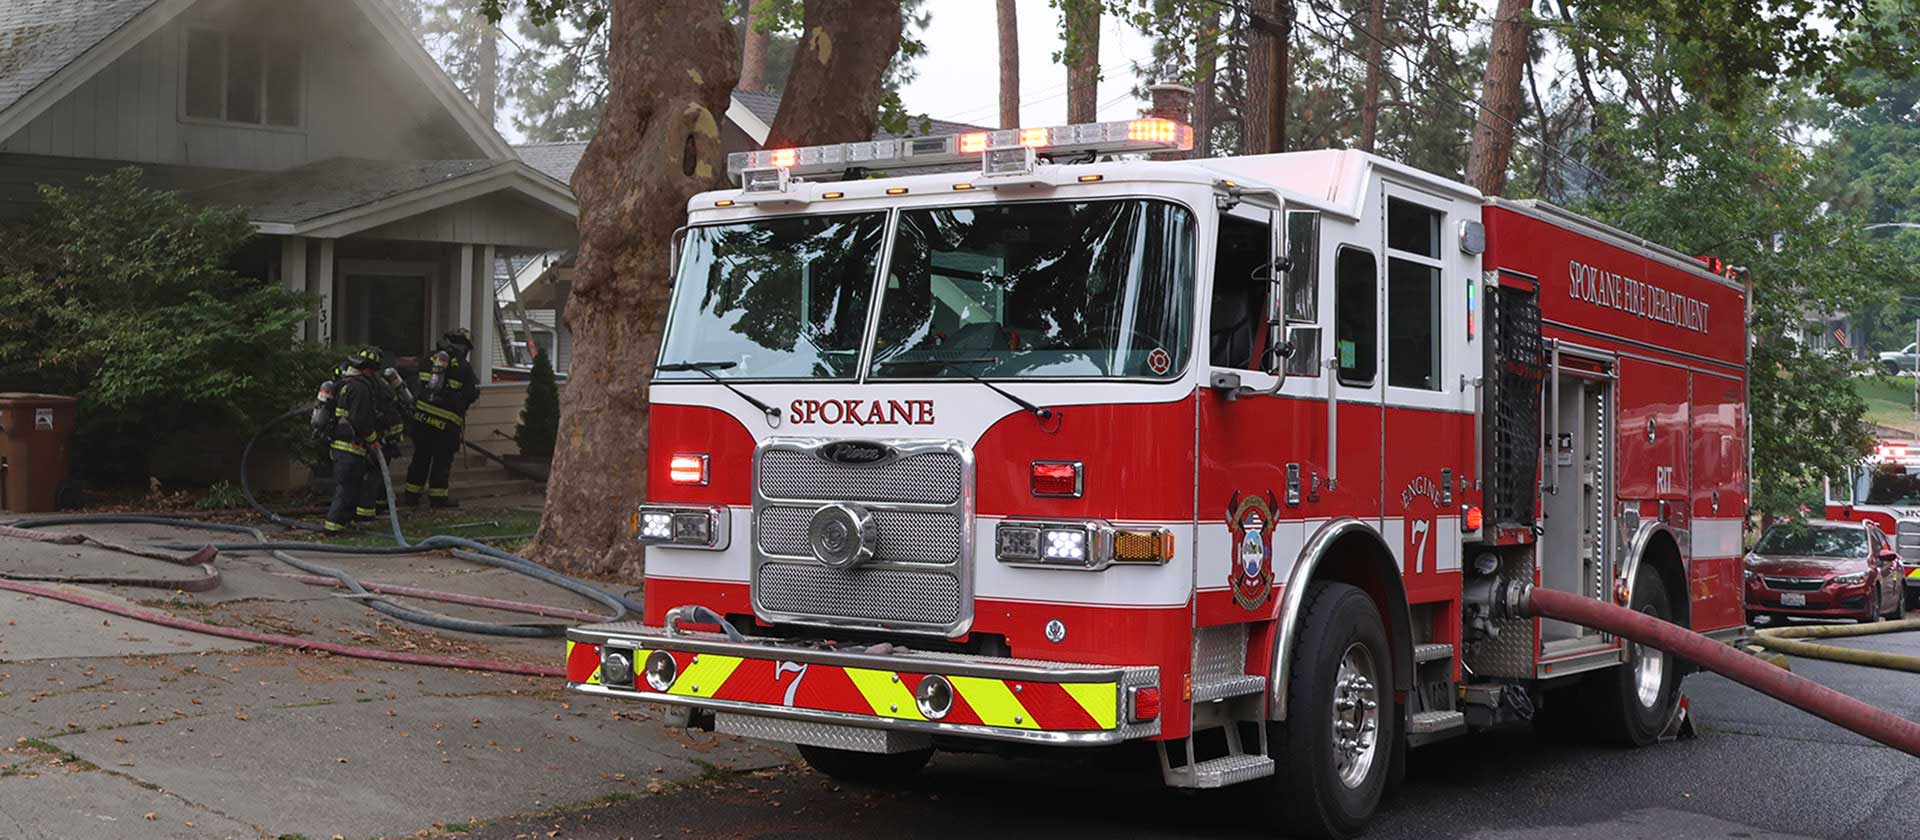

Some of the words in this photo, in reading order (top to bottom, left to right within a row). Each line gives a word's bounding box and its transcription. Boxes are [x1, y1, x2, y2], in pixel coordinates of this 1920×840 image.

[1569, 260, 1621, 310] SPOKANE
[1624, 277, 1645, 316] FIRE
[1648, 285, 1710, 334] DEPARTMENT
[790, 399, 935, 426] SPOKANE
[832, 444, 880, 461] Pierce
[1402, 476, 1440, 508] ENGINE
[1657, 466, 1672, 494] RIT
[1411, 519, 1430, 574] 7
[775, 660, 808, 707] 7
